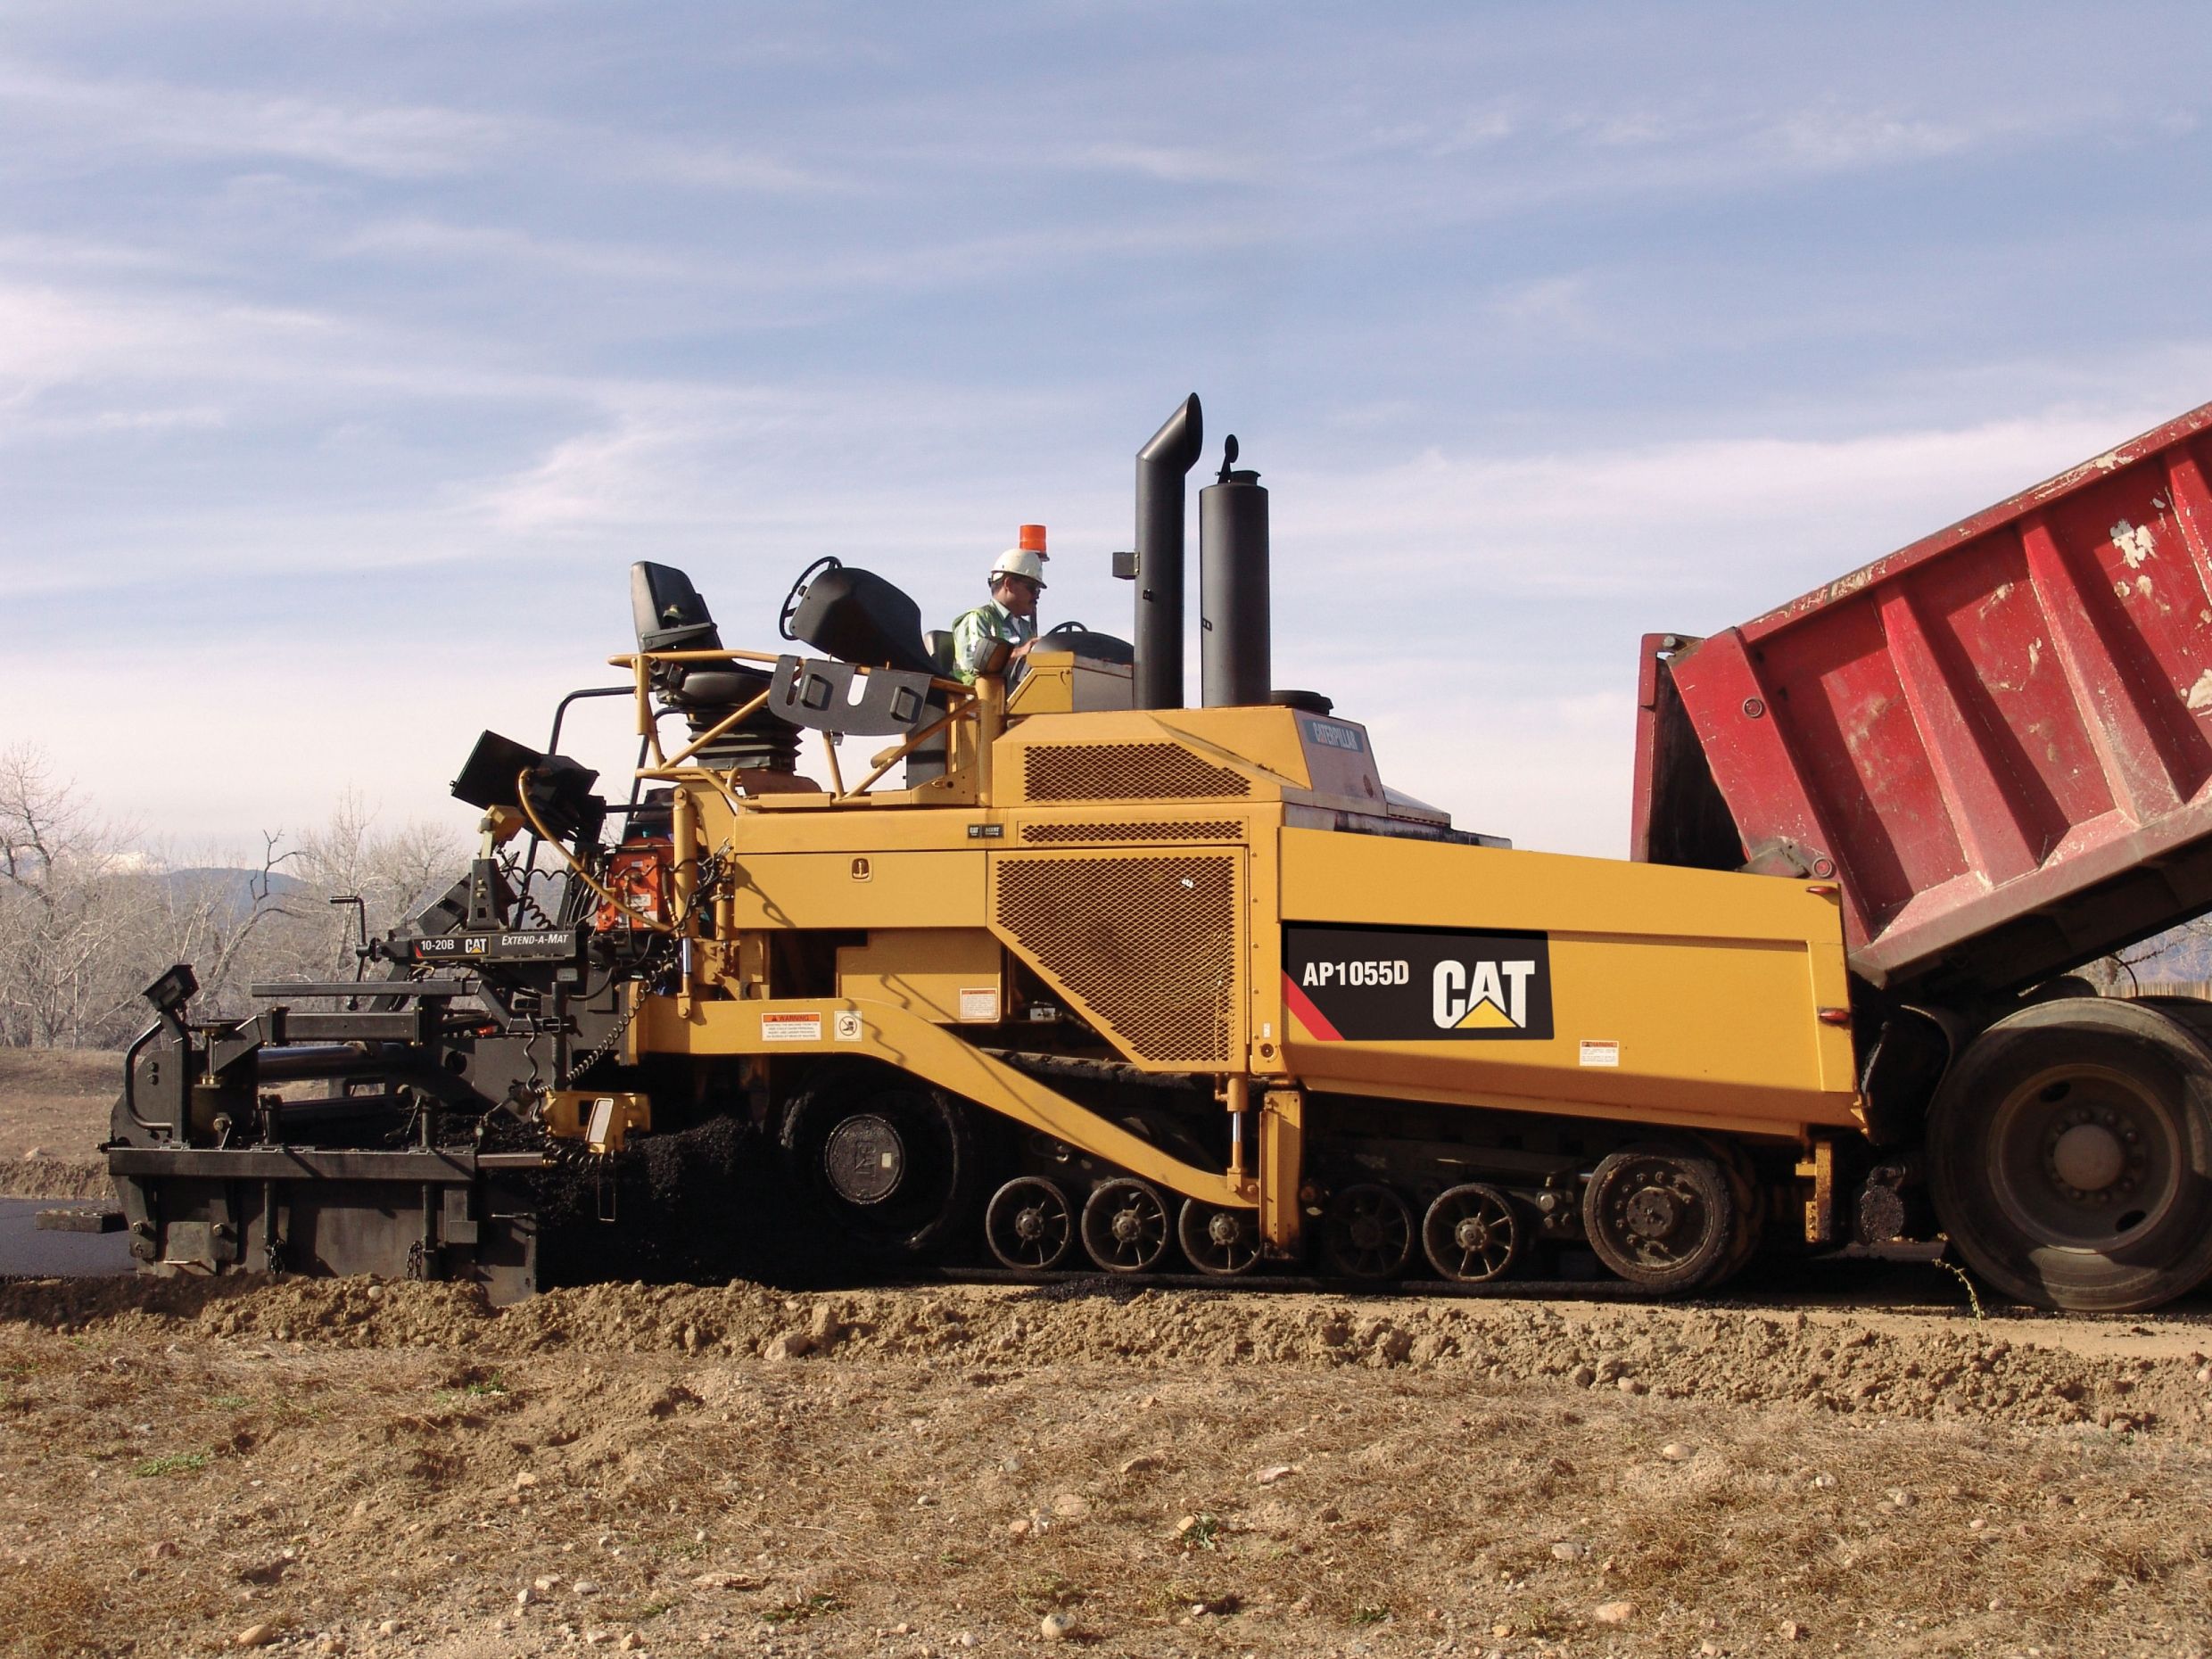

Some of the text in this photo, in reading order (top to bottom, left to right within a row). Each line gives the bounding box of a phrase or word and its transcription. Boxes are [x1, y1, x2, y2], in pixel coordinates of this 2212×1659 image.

[1312, 722, 1358, 750] CATERPILLAR
[420, 938, 487, 954] 10-20B CAT
[501, 933, 569, 946] EXTEND-A-MAT
[1302, 960, 1409, 986] AP1055D
[1432, 959, 1536, 1029] CAT
